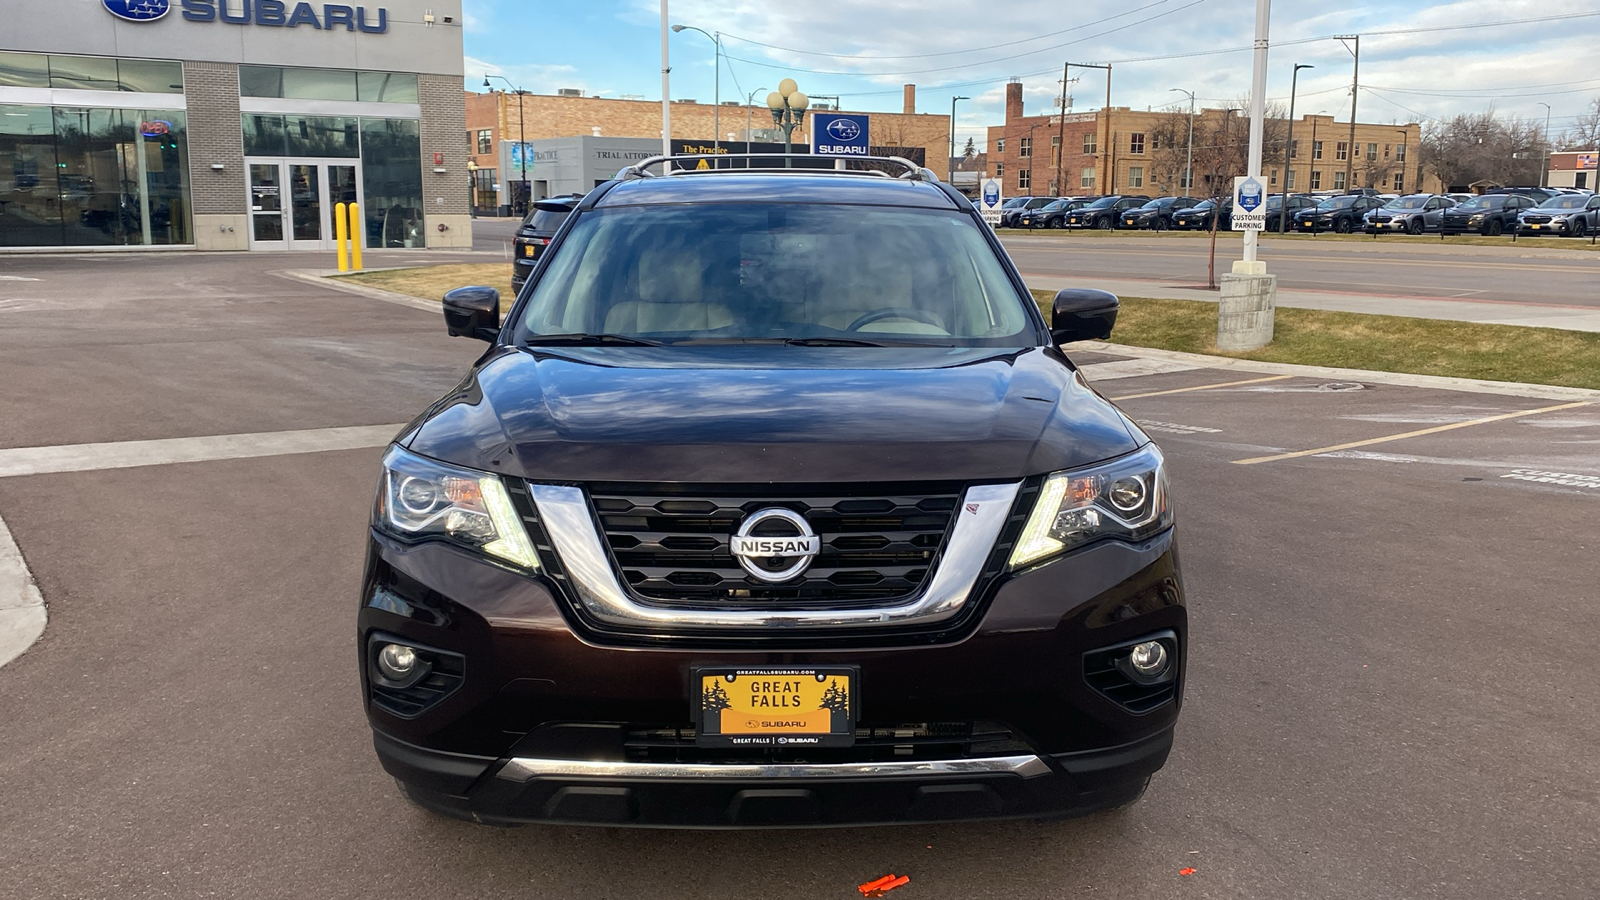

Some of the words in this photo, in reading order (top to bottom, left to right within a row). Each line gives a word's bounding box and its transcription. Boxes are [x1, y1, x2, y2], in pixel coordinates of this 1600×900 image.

[182, 0, 388, 34] SUBARU
[140, 121, 169, 134] OPEN
[596, 151, 621, 159] TRIAL
[683, 145, 698, 153] The
[699, 146, 728, 154] Pracice
[819, 145, 866, 154] SUBARU
[740, 540, 810, 553] NISSAN
[750, 681, 801, 693] GREAT
[751, 695, 801, 708] FALLS
